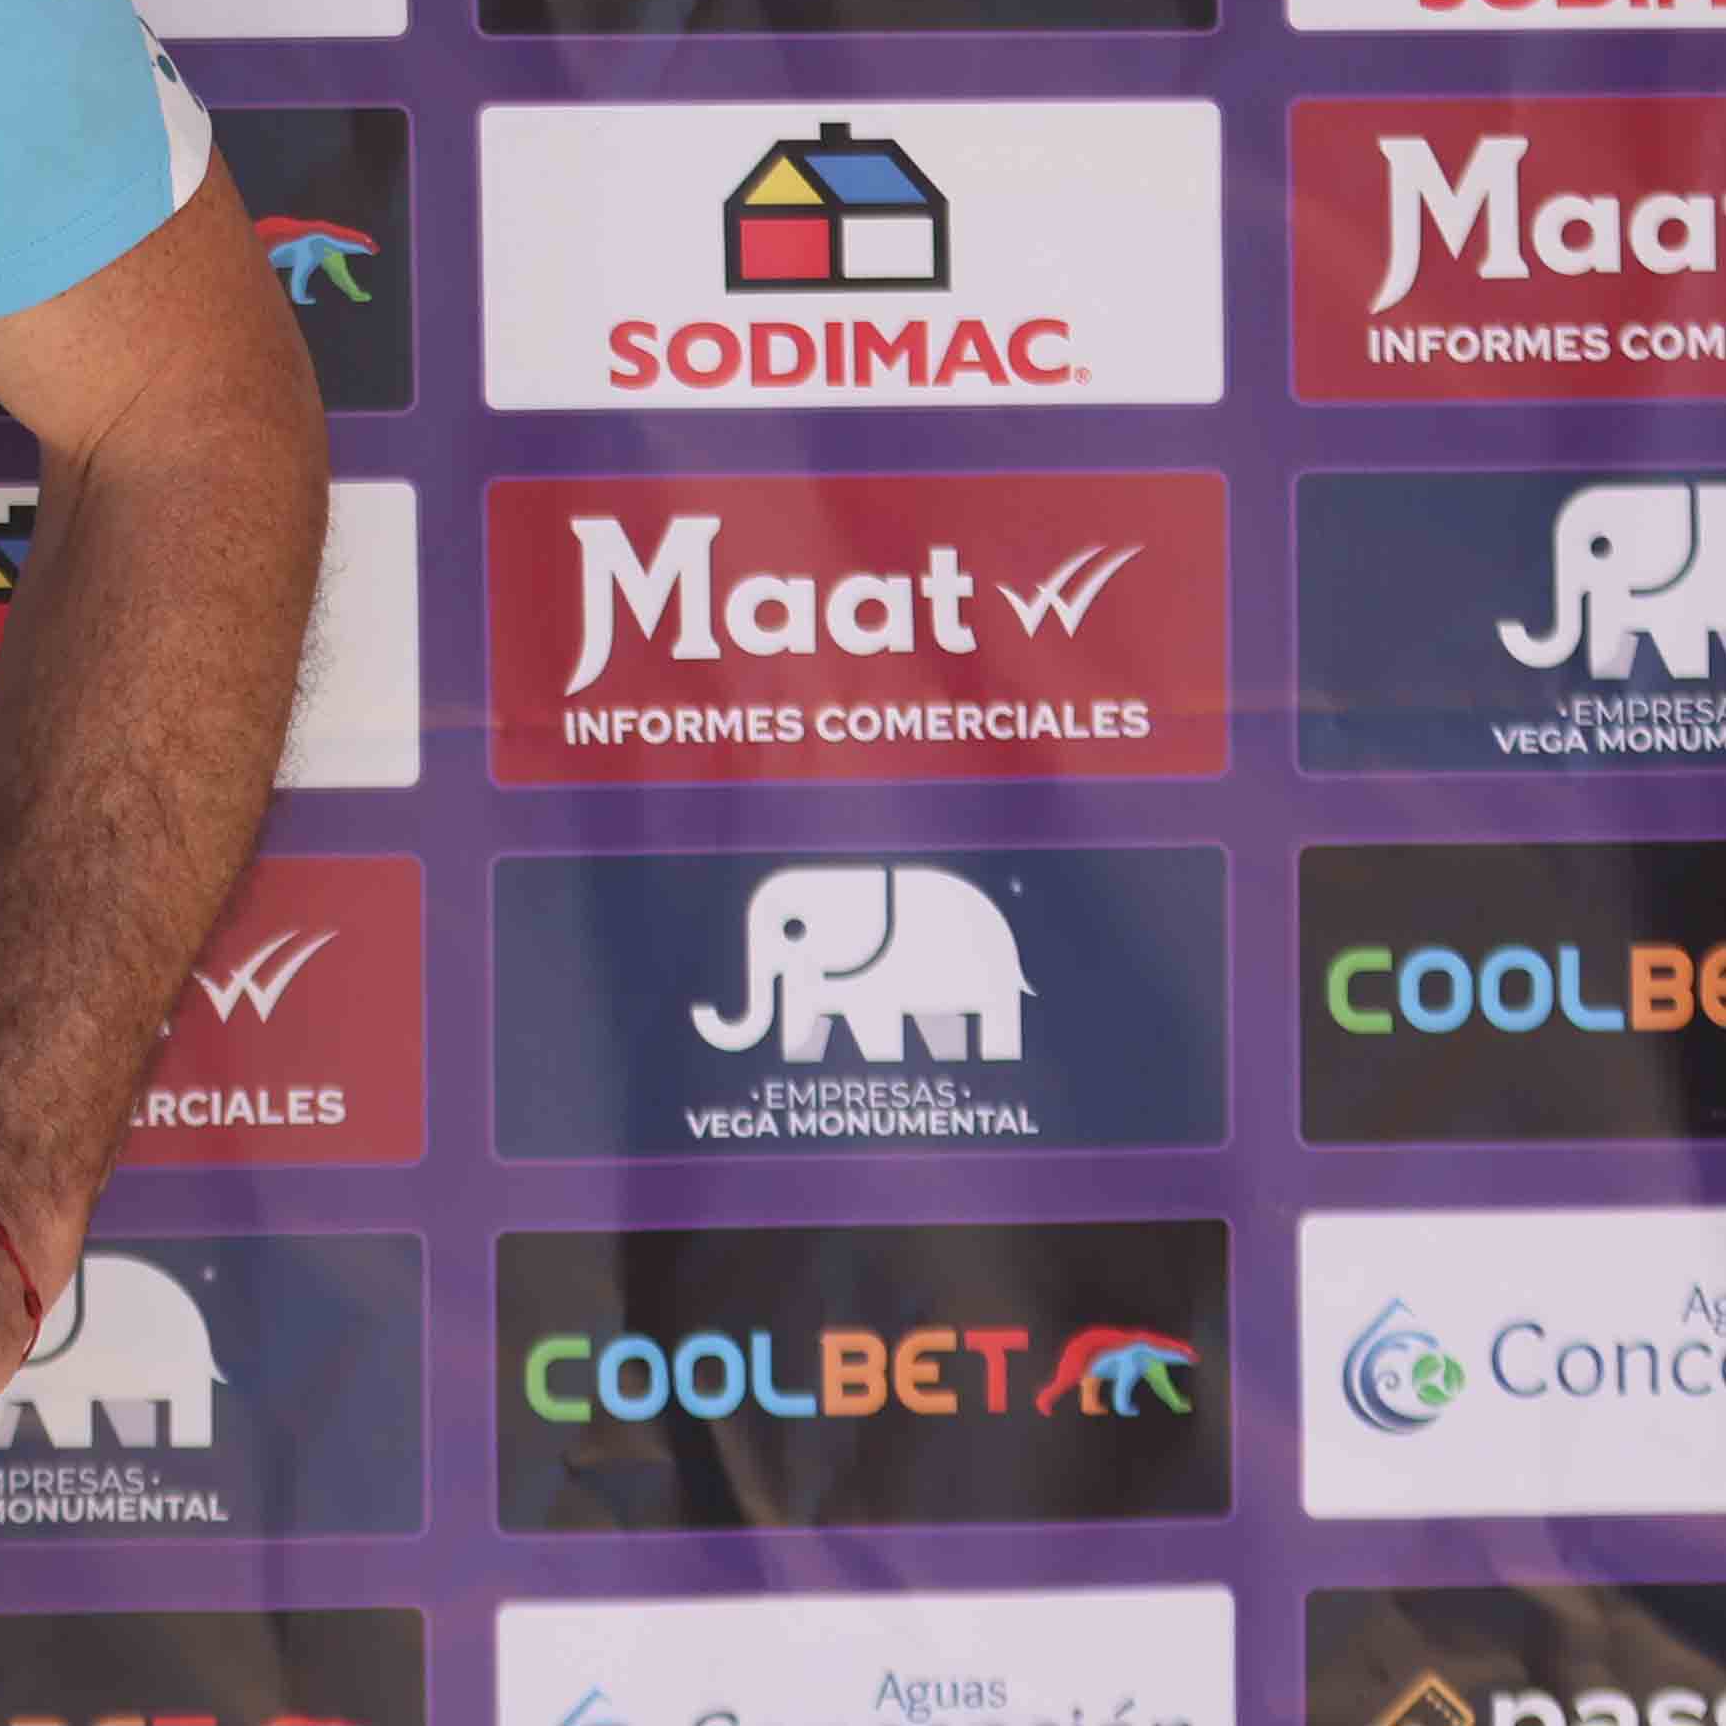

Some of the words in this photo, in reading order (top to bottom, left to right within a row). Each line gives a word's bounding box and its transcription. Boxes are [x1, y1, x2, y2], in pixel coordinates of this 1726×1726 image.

[1370, 135, 1726, 315] Maa
[1369, 329, 1611, 363] INFORMES
[565, 515, 976, 699] Maat
[565, 706, 805, 746] INFORMES
[816, 700, 1150, 742] COMERCIALES
[1493, 725, 1589, 755] VEGA
[686, 1111, 779, 1139] VEGA
[789, 1106, 1039, 1138] MONUMENTAL
[525, 1329, 1029, 1422] COOLBET
[1492, 1320, 1726, 1398] Conc
[876, 1670, 1007, 1716] Aguas
